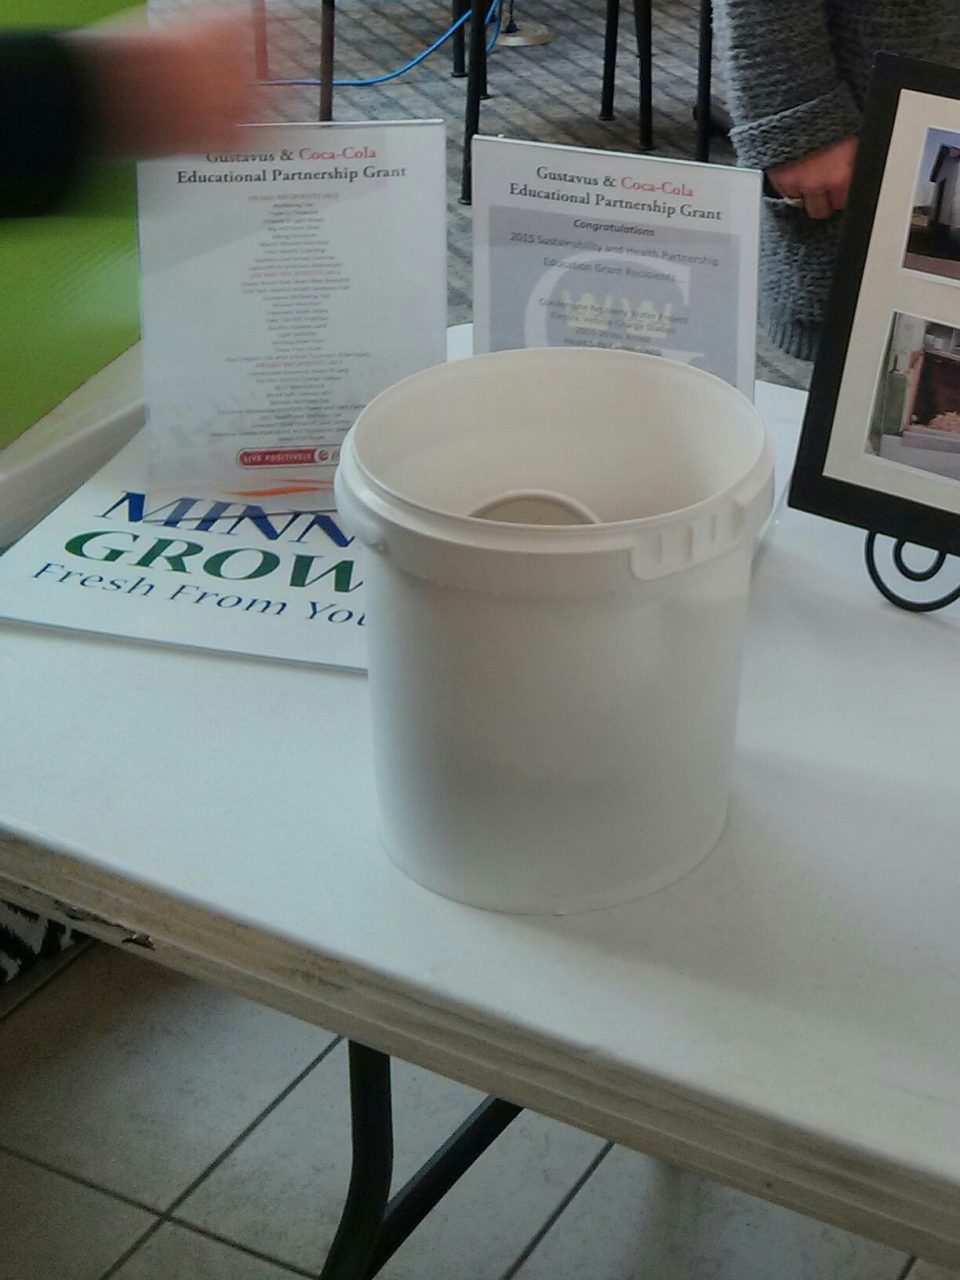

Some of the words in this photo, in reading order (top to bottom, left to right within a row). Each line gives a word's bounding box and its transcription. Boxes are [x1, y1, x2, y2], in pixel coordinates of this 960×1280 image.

[280, 149, 294, 161] &
[299, 146, 377, 161] Coca-Cola
[177, 169, 267, 184] Educational
[272, 167, 359, 183] Partnership
[363, 165, 407, 179] Grant
[536, 166, 599, 187] Gustavus
[602, 175, 617, 188] &
[620, 176, 694, 197] Coca-Cola
[509, 182, 591, 206] Educational
[594, 194, 676, 218] Partnership
[679, 203, 722, 220] Grant
[572, 219, 655, 237] Congratulations
[64, 530, 364, 593] GROW
[33, 562, 154, 596] Fresh
[167, 584, 289, 616] From
